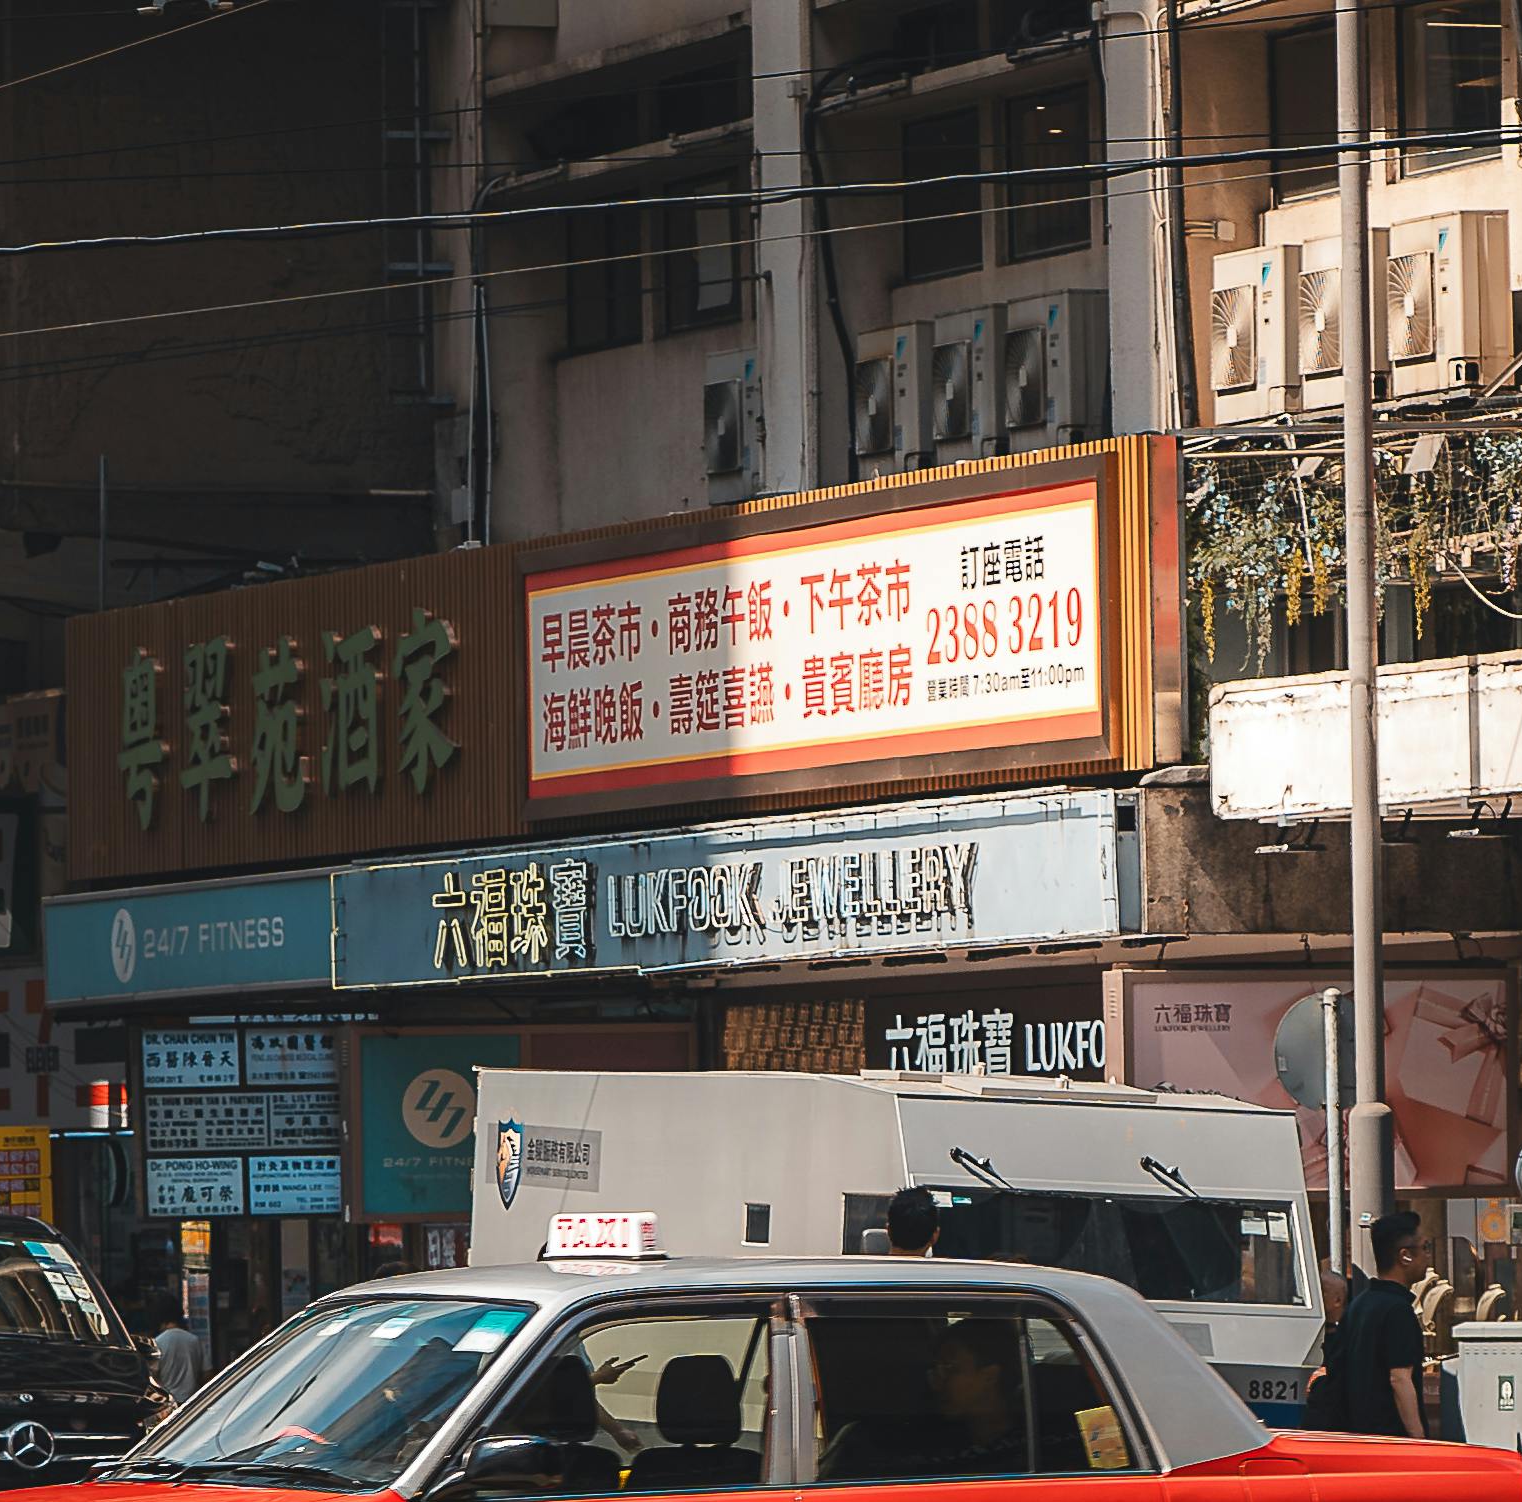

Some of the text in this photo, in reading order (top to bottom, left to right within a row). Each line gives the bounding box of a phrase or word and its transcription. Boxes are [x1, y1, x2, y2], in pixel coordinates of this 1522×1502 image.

[961, 536, 1046, 591] 訂座電話
[926, 587, 1083, 665] 2388 3219
[927, 675, 970, 704] 營業時間
[432, 857, 589, 969] 六福珠寶
[608, 841, 976, 936] LUKFOOK JEWELLERY
[142, 915, 284, 959] 24/7 FITNESS
[1154, 1003, 1232, 1024] 六福珠寶
[885, 1007, 1014, 1076] 六福珠寶
[557, 1218, 629, 1249] TAXI
[1249, 1380, 1299, 1400] 8821
